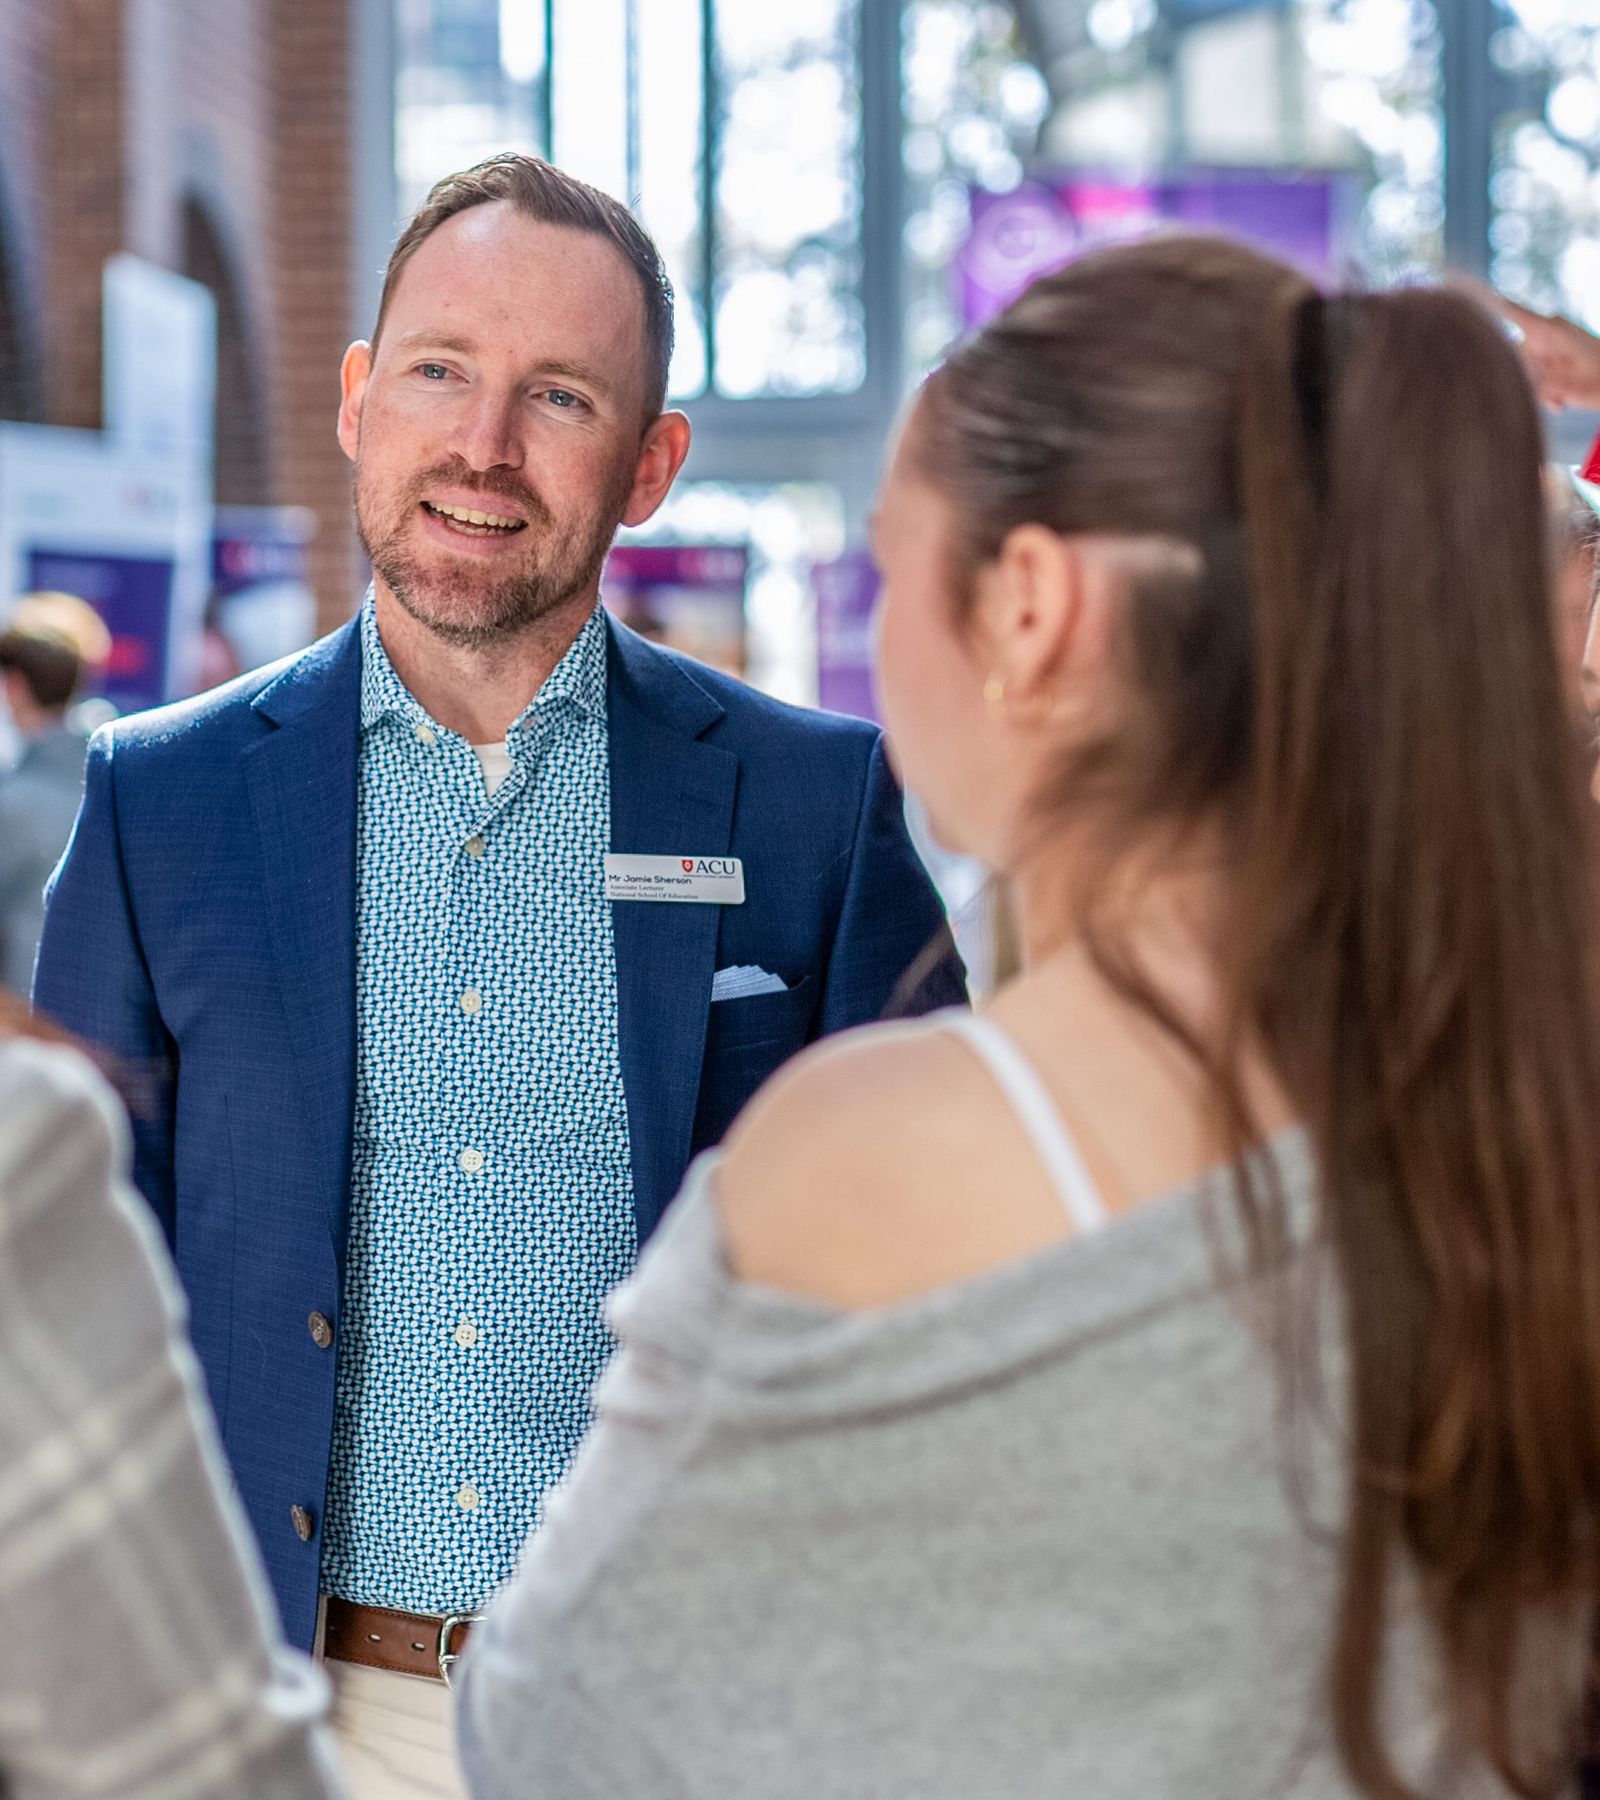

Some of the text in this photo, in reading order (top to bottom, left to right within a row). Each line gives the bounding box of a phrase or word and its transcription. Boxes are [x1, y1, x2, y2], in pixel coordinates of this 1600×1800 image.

[696, 859, 735, 875] ACU
[608, 874, 621, 882] Mr
[623, 875, 652, 883] Jamie
[653, 875, 692, 885] Sherson
